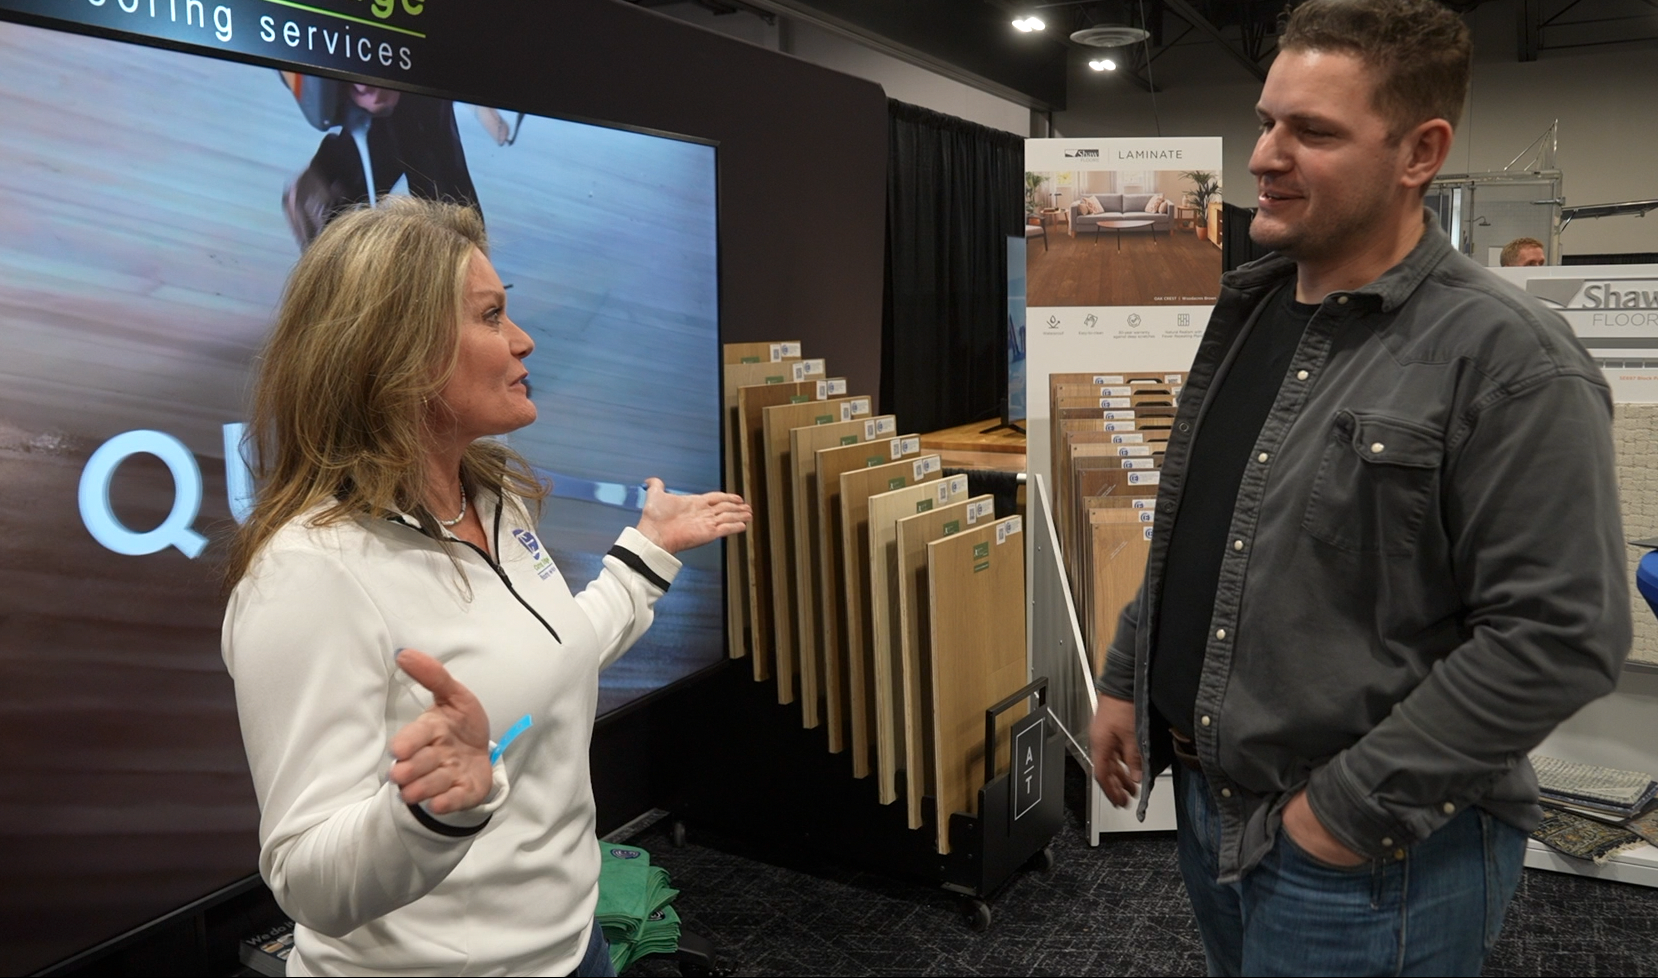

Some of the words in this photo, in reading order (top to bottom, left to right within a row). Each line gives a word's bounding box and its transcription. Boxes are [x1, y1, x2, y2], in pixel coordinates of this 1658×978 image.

[259, 15, 412, 70] services
[1118, 150, 1183, 160] LAMINATE
[1582, 283, 1658, 309] Shaw
[245, 934, 271, 946] We
